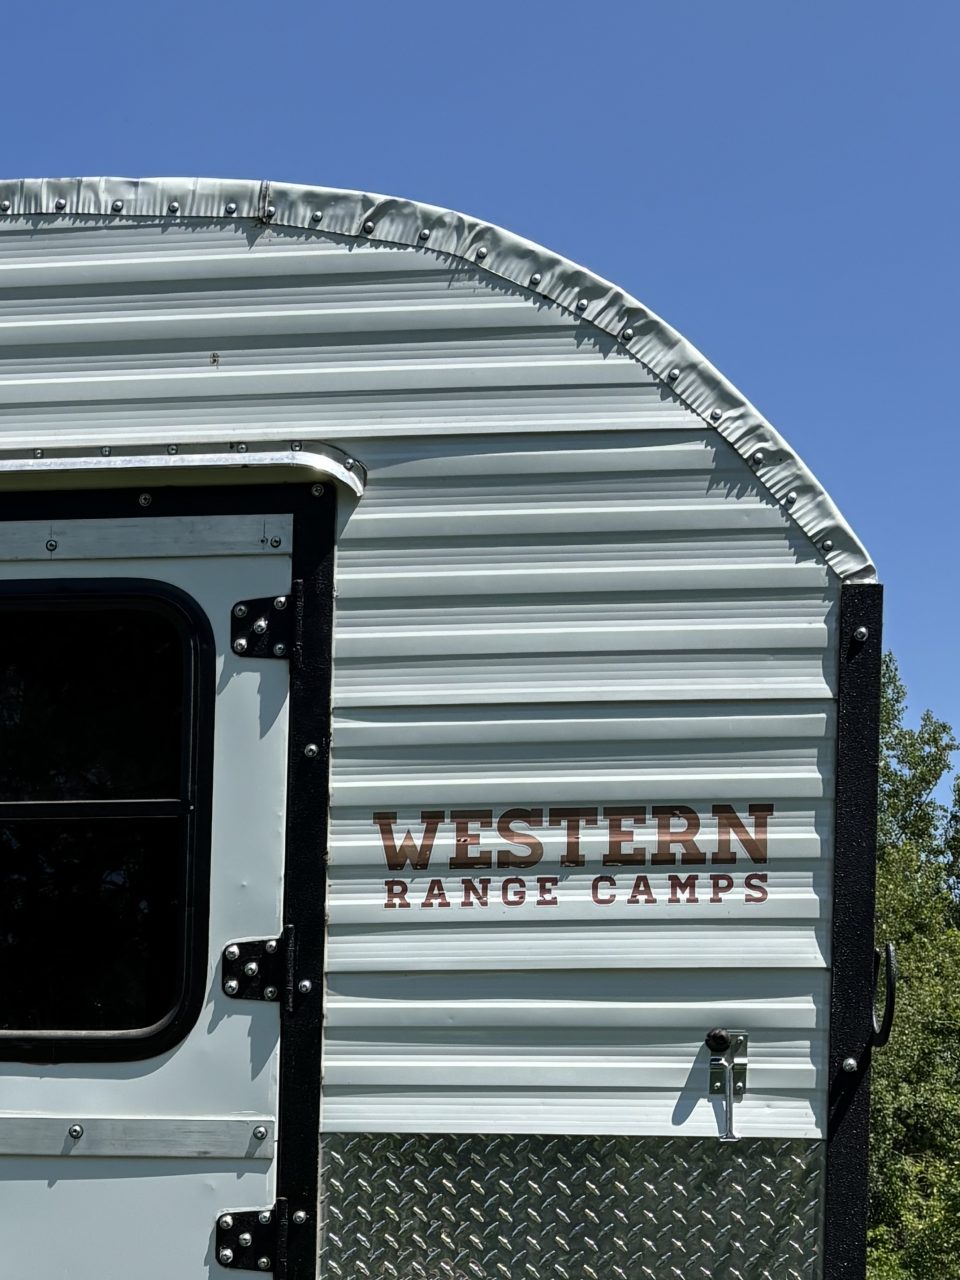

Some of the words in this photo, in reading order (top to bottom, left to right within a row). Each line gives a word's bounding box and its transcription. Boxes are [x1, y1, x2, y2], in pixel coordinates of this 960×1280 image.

[372, 803, 775, 871] WESTERN
[383, 876, 560, 909] RANGE
[590, 872, 769, 905] CAMPS
